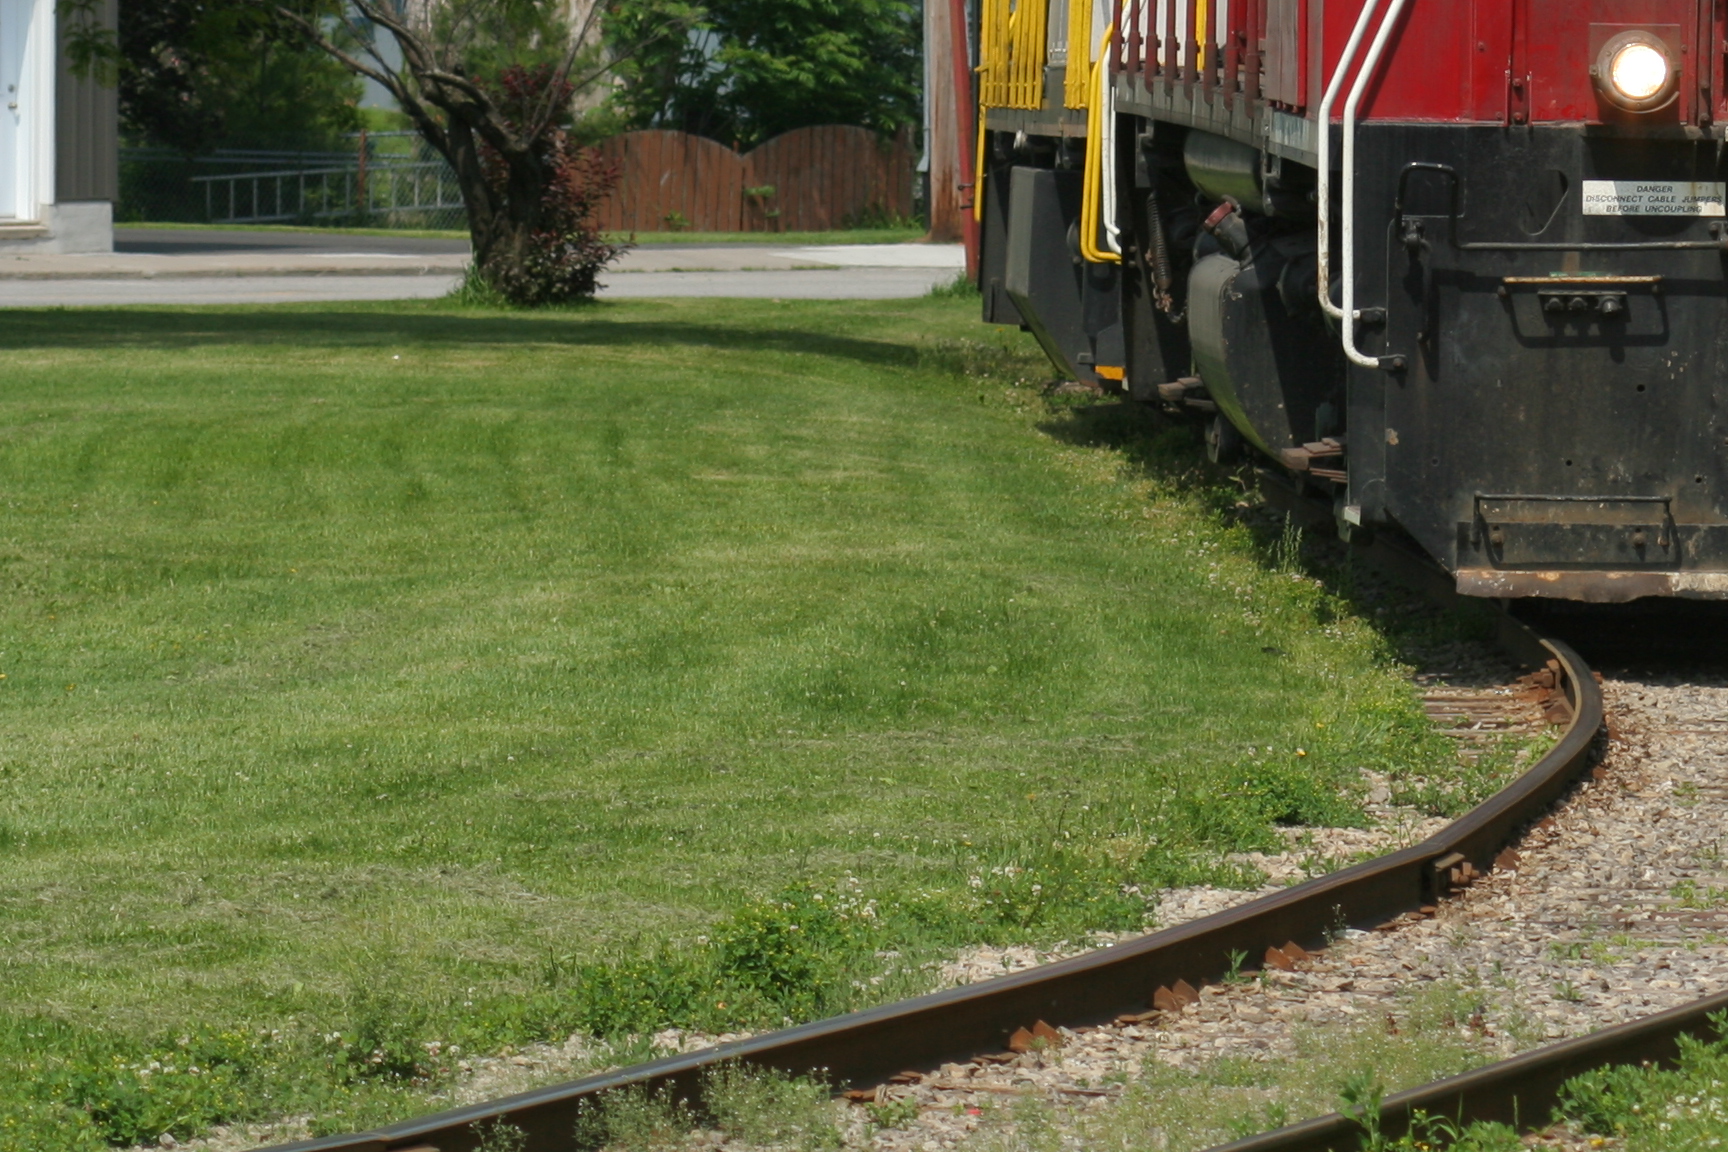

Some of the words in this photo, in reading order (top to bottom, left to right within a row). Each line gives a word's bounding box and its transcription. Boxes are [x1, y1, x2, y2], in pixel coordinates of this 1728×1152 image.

[1636, 185, 1673, 193] DANGER
[1586, 195, 1643, 203] DISCONNECT
[1682, 196, 1722, 204] JUMPERS
[1606, 205, 1641, 213] BEFORE
[1645, 205, 1702, 213] UNCOUPLING
